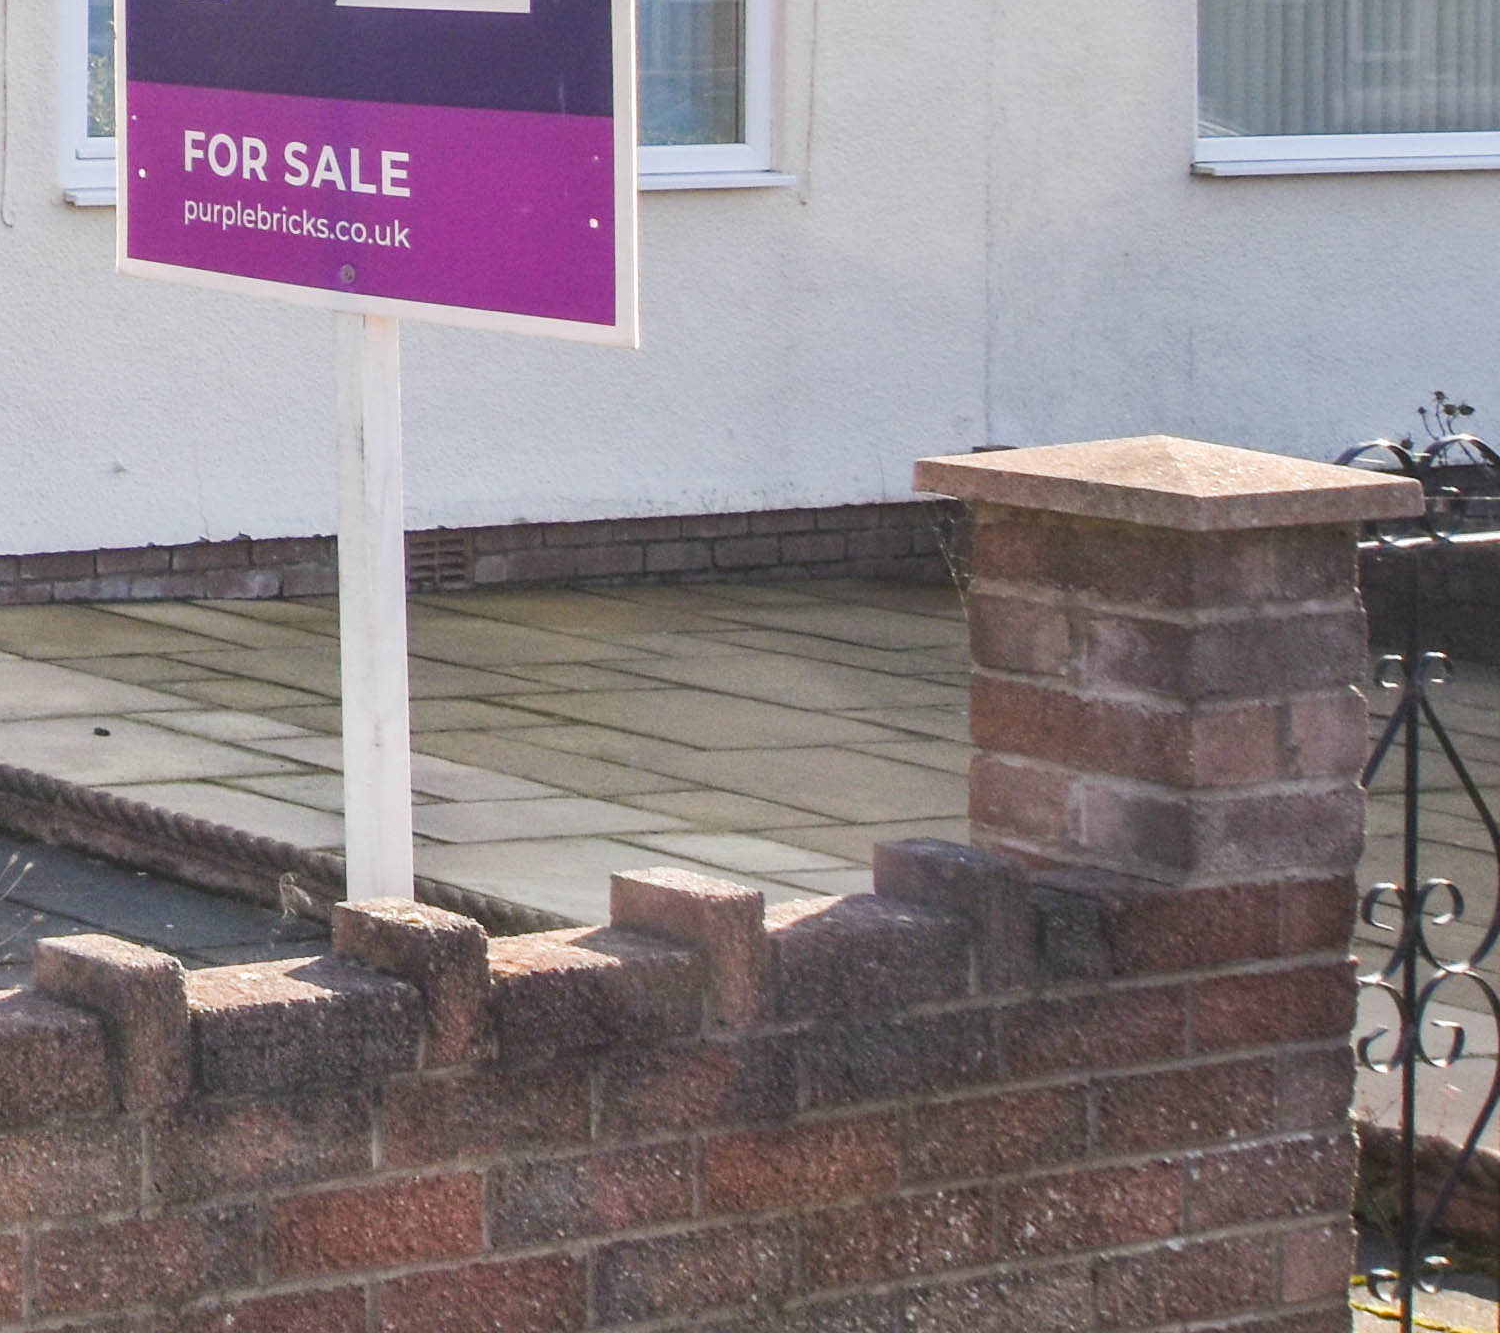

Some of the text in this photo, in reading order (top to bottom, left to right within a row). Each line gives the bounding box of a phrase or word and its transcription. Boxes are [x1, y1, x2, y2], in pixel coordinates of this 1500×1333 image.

[183, 129, 411, 197] FOR SALE
[183, 200, 411, 248] purplebricks.co.uk
